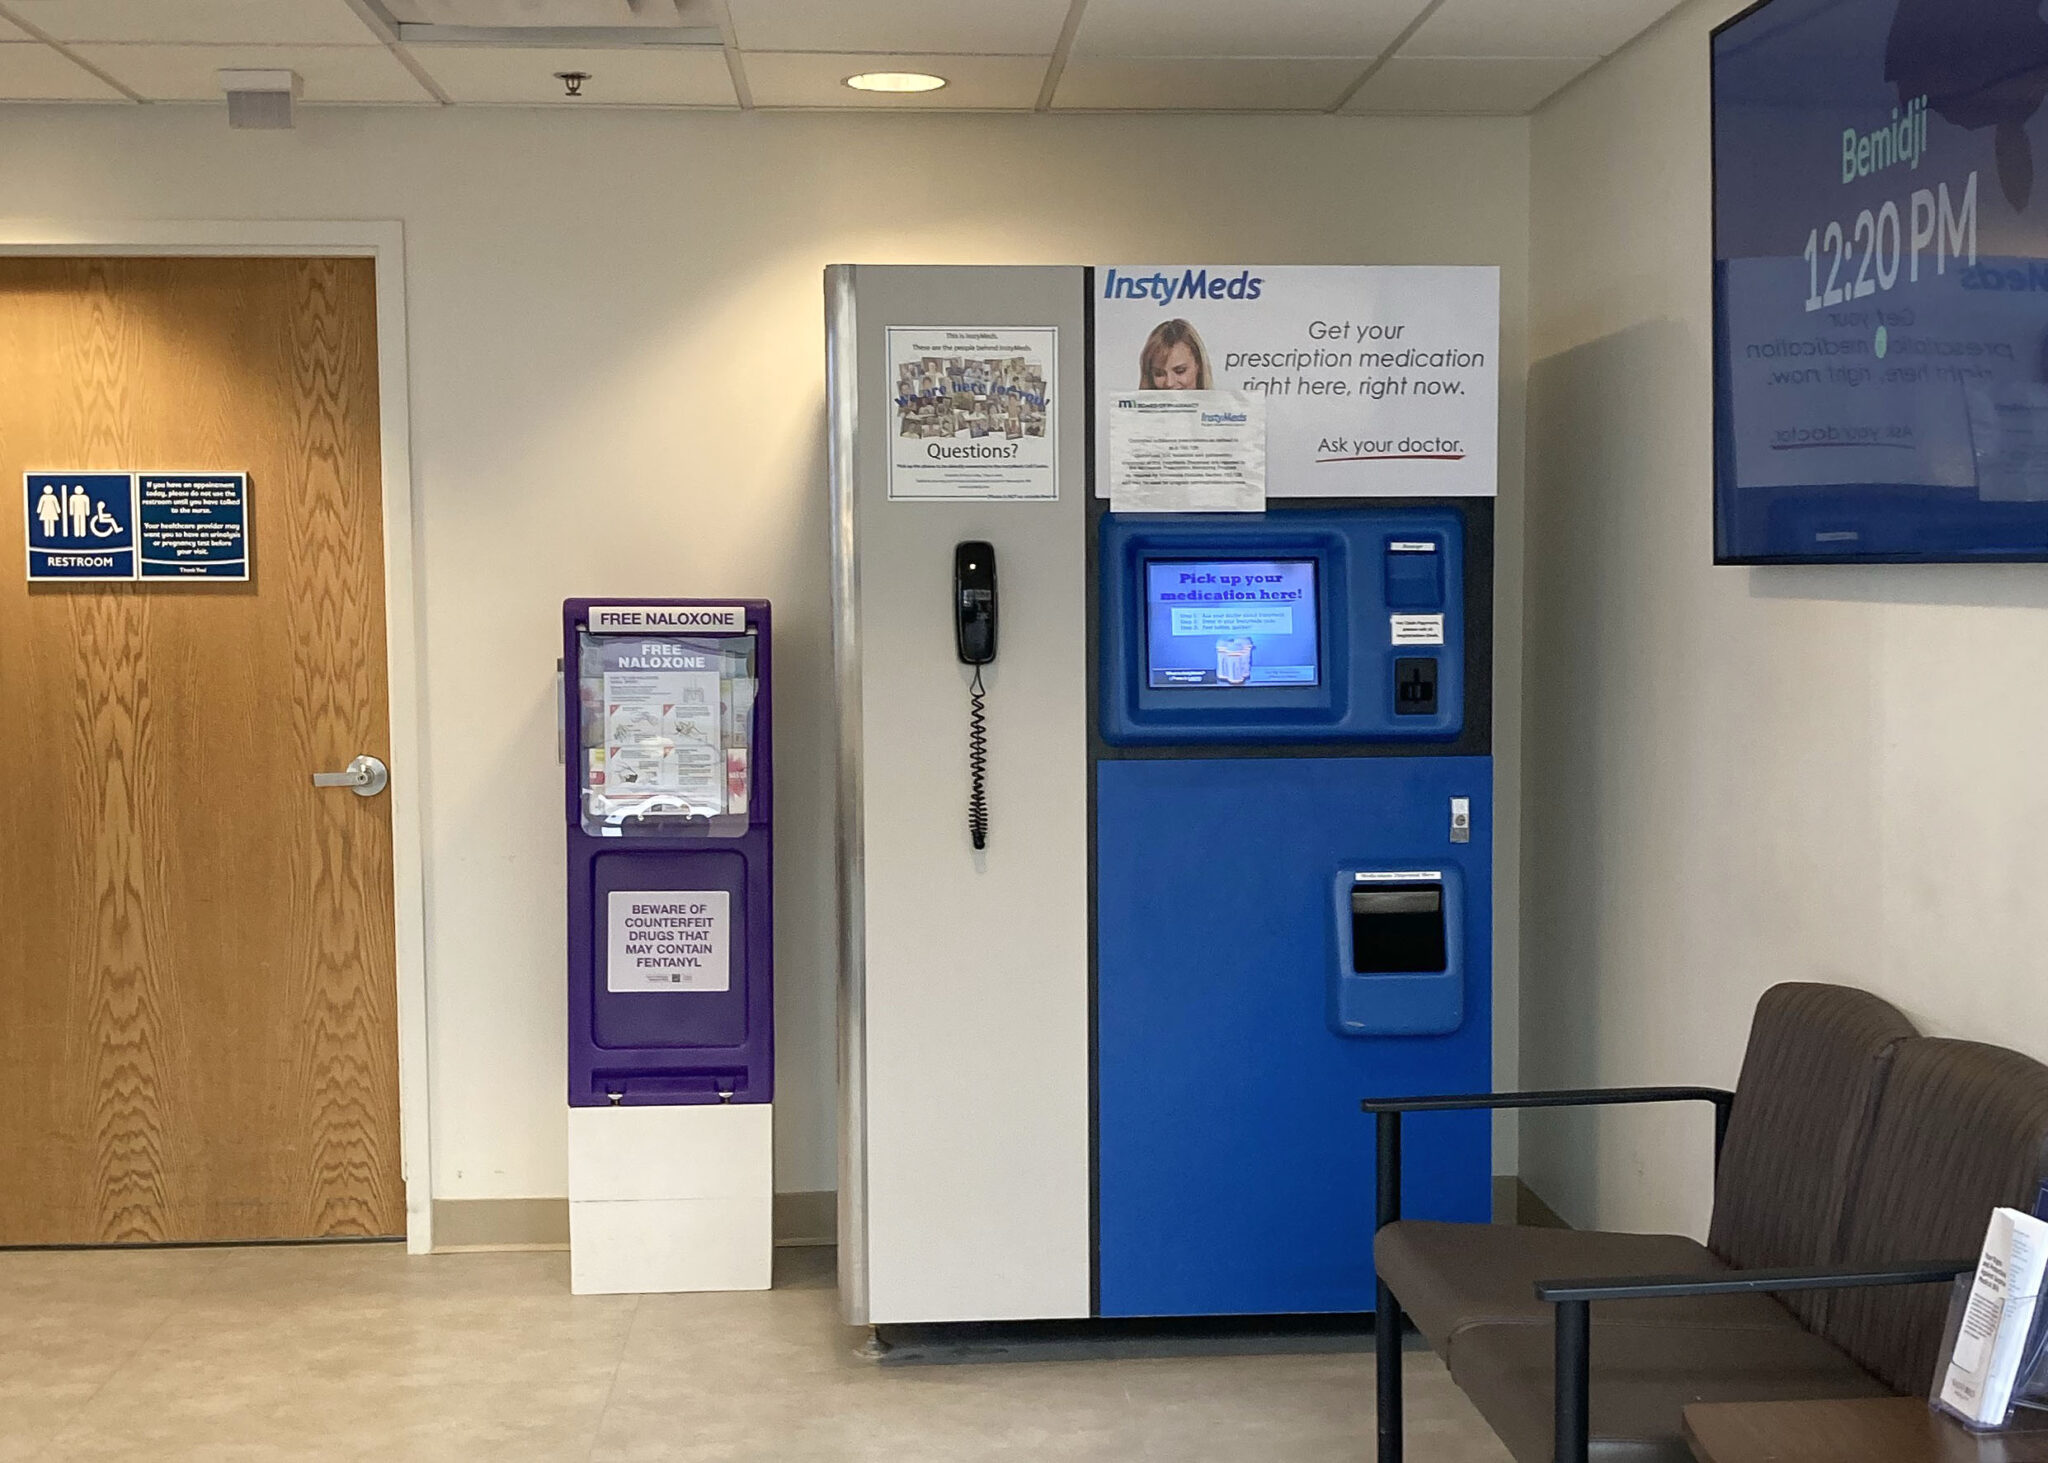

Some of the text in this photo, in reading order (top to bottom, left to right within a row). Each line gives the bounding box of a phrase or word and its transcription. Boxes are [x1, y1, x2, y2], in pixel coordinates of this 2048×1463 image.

[1842, 94, 1928, 184] Bemidji
[1804, 170, 1978, 312] 12:20 PM
[1104, 269, 1263, 306] InstyMeds
[1309, 320, 1405, 343] Get your
[1225, 348, 1484, 371] prescription medication
[952, 381, 986, 394] here
[1297, 376, 1351, 396] here,
[1359, 376, 1408, 399] right
[1413, 381, 1465, 395] now.
[927, 443, 1019, 460] Questions?
[1317, 437, 1464, 455] Ask your doctor.
[153, 482, 165, 490] you
[168, 490, 189, 498] please
[47, 556, 113, 567] RESTROOM
[1179, 573, 1283, 587] Pick up your
[1160, 589, 1302, 600] medication here!
[600, 612, 734, 625] FREE NALOXONE
[641, 644, 682, 655] FREE
[618, 657, 706, 668] NALOXONE
[632, 904, 708, 914] BEWARE OF
[625, 918, 714, 928] COUNTERFEIT
[629, 931, 709, 941] DRUGS THAT
[625, 944, 713, 954] MAY CONTAIN
[636, 957, 702, 968] FENTANYL
